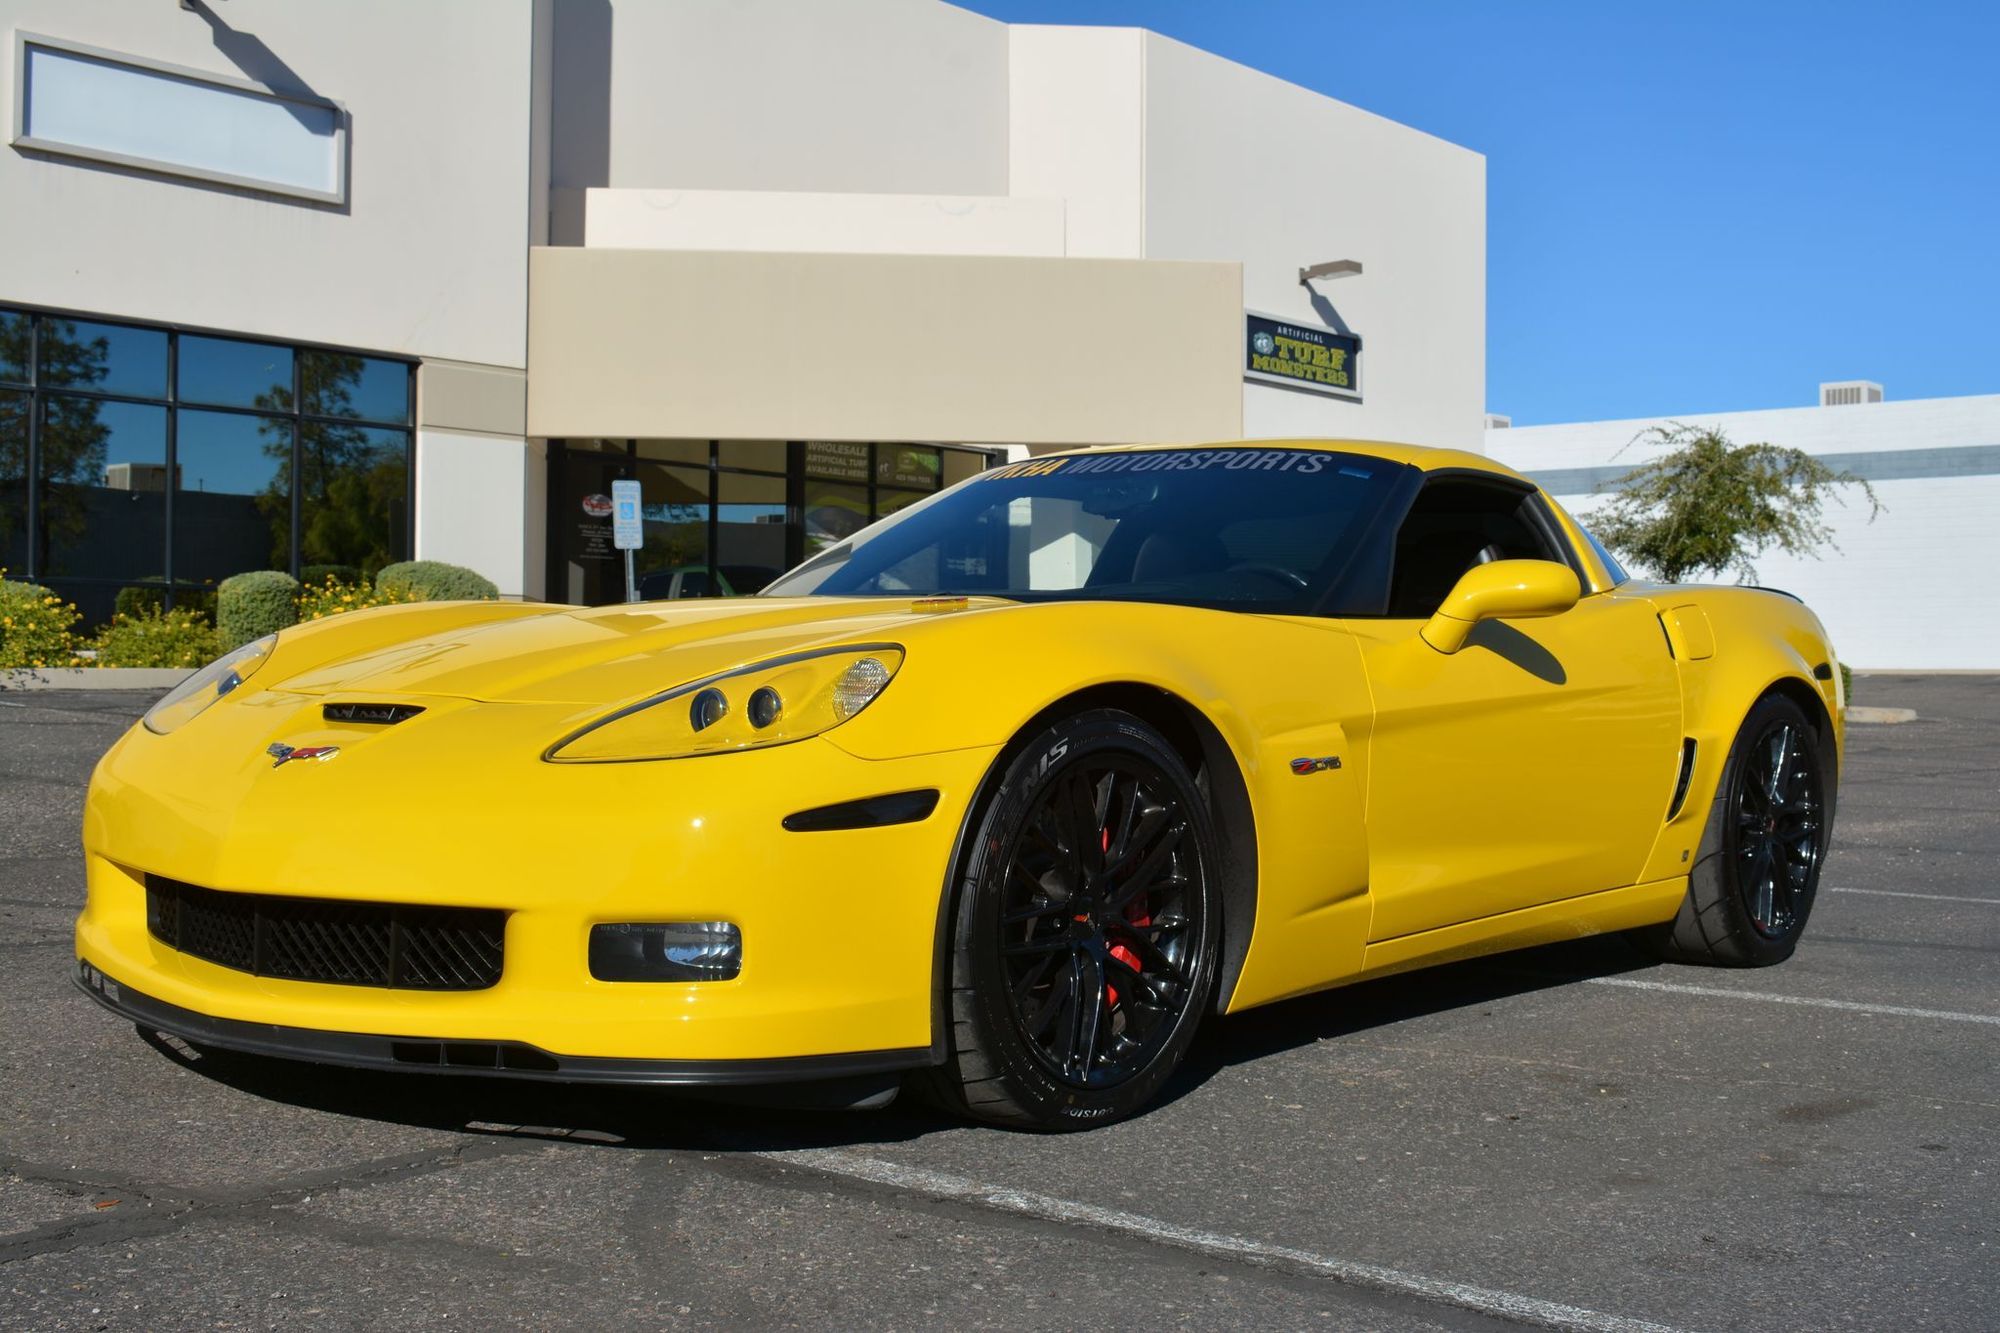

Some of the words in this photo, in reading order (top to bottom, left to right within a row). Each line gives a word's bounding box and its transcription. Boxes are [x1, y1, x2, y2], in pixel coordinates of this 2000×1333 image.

[1277, 326, 1323, 344] ARTIFICIAL
[1275, 336, 1346, 370] TURF
[1252, 354, 1348, 386] MONSTERS
[807, 441, 867, 456] WHOLESALE
[807, 454, 847, 465] ARTIFICIAL
[1061, 451, 1332, 474] MOTORSPORTS
[806, 464, 846, 476] AVAILABLE
